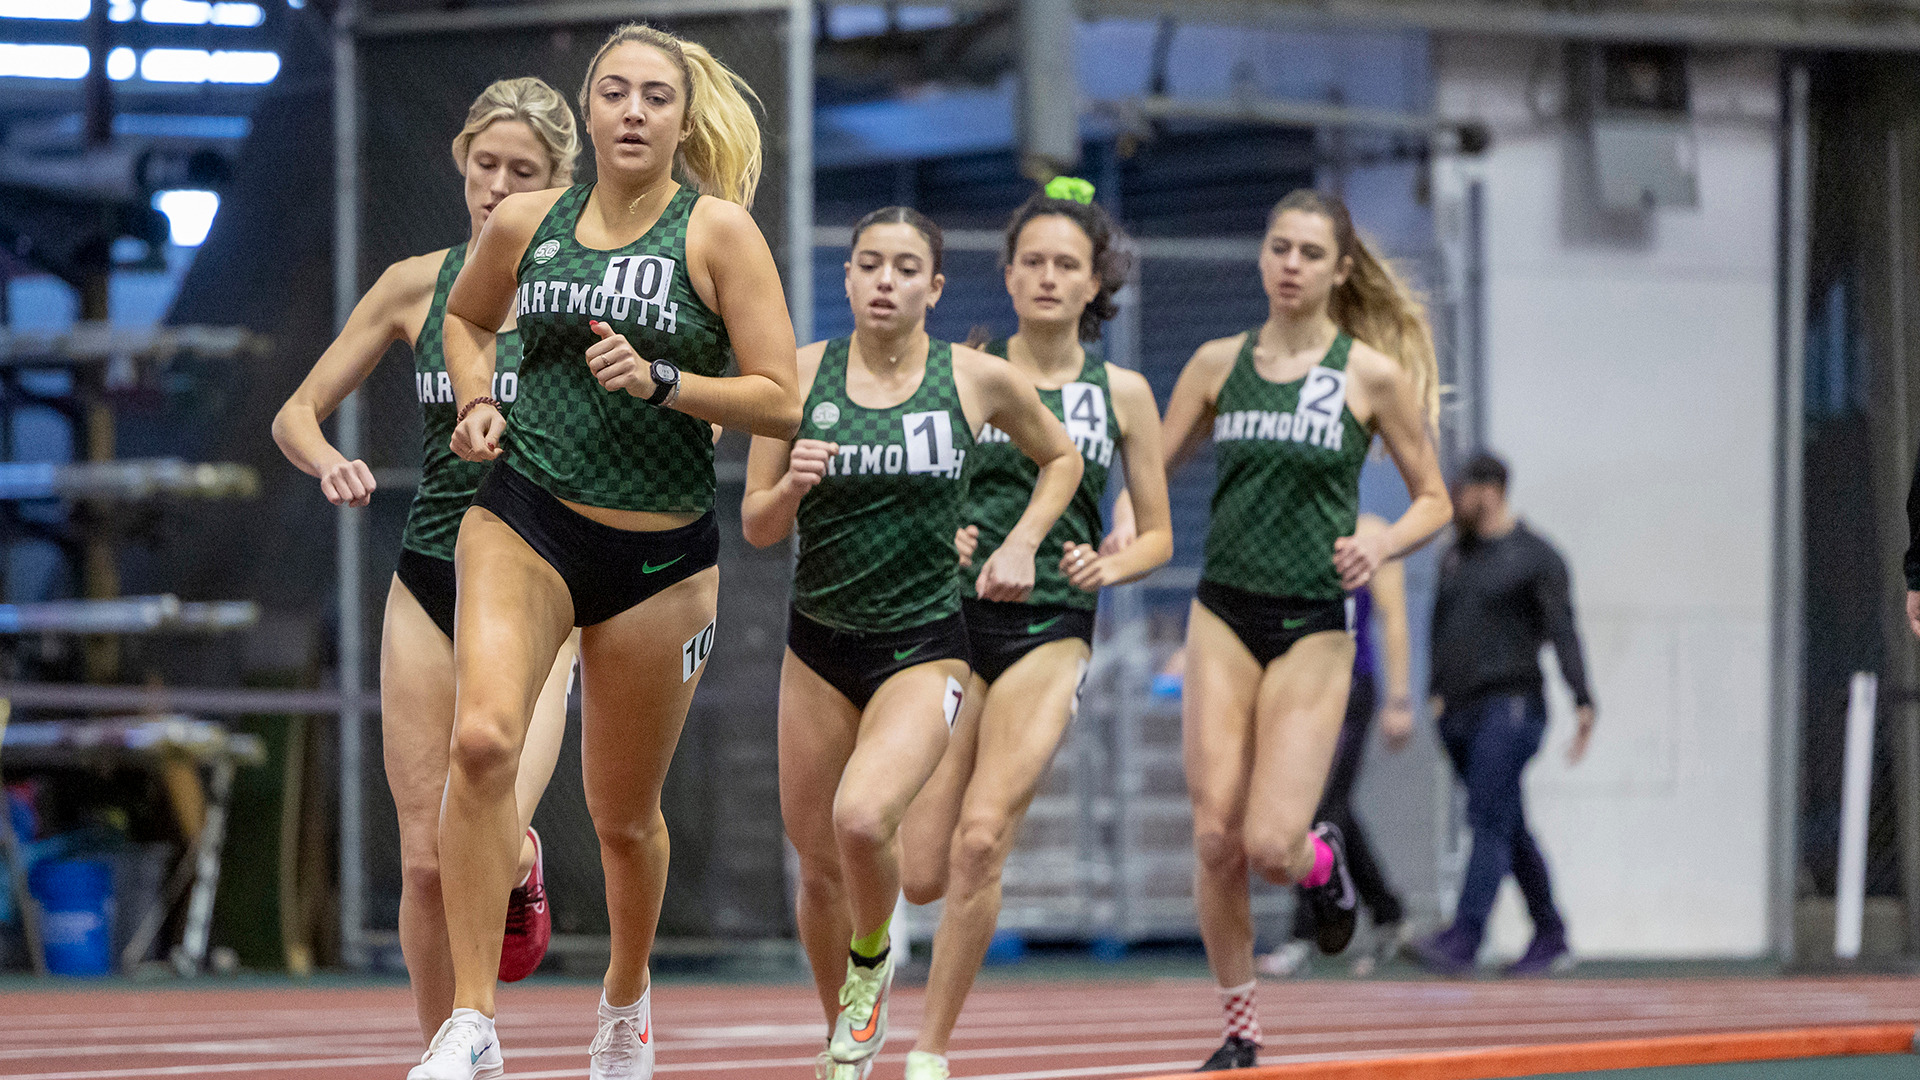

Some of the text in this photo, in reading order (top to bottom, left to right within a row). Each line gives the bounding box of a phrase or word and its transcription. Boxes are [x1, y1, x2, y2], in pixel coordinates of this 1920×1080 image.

[612, 257, 663, 299] 10
[1071, 388, 1101, 432] 4
[1306, 374, 1340, 416] 2
[913, 415, 939, 465] 1
[685, 622, 714, 675] 10
